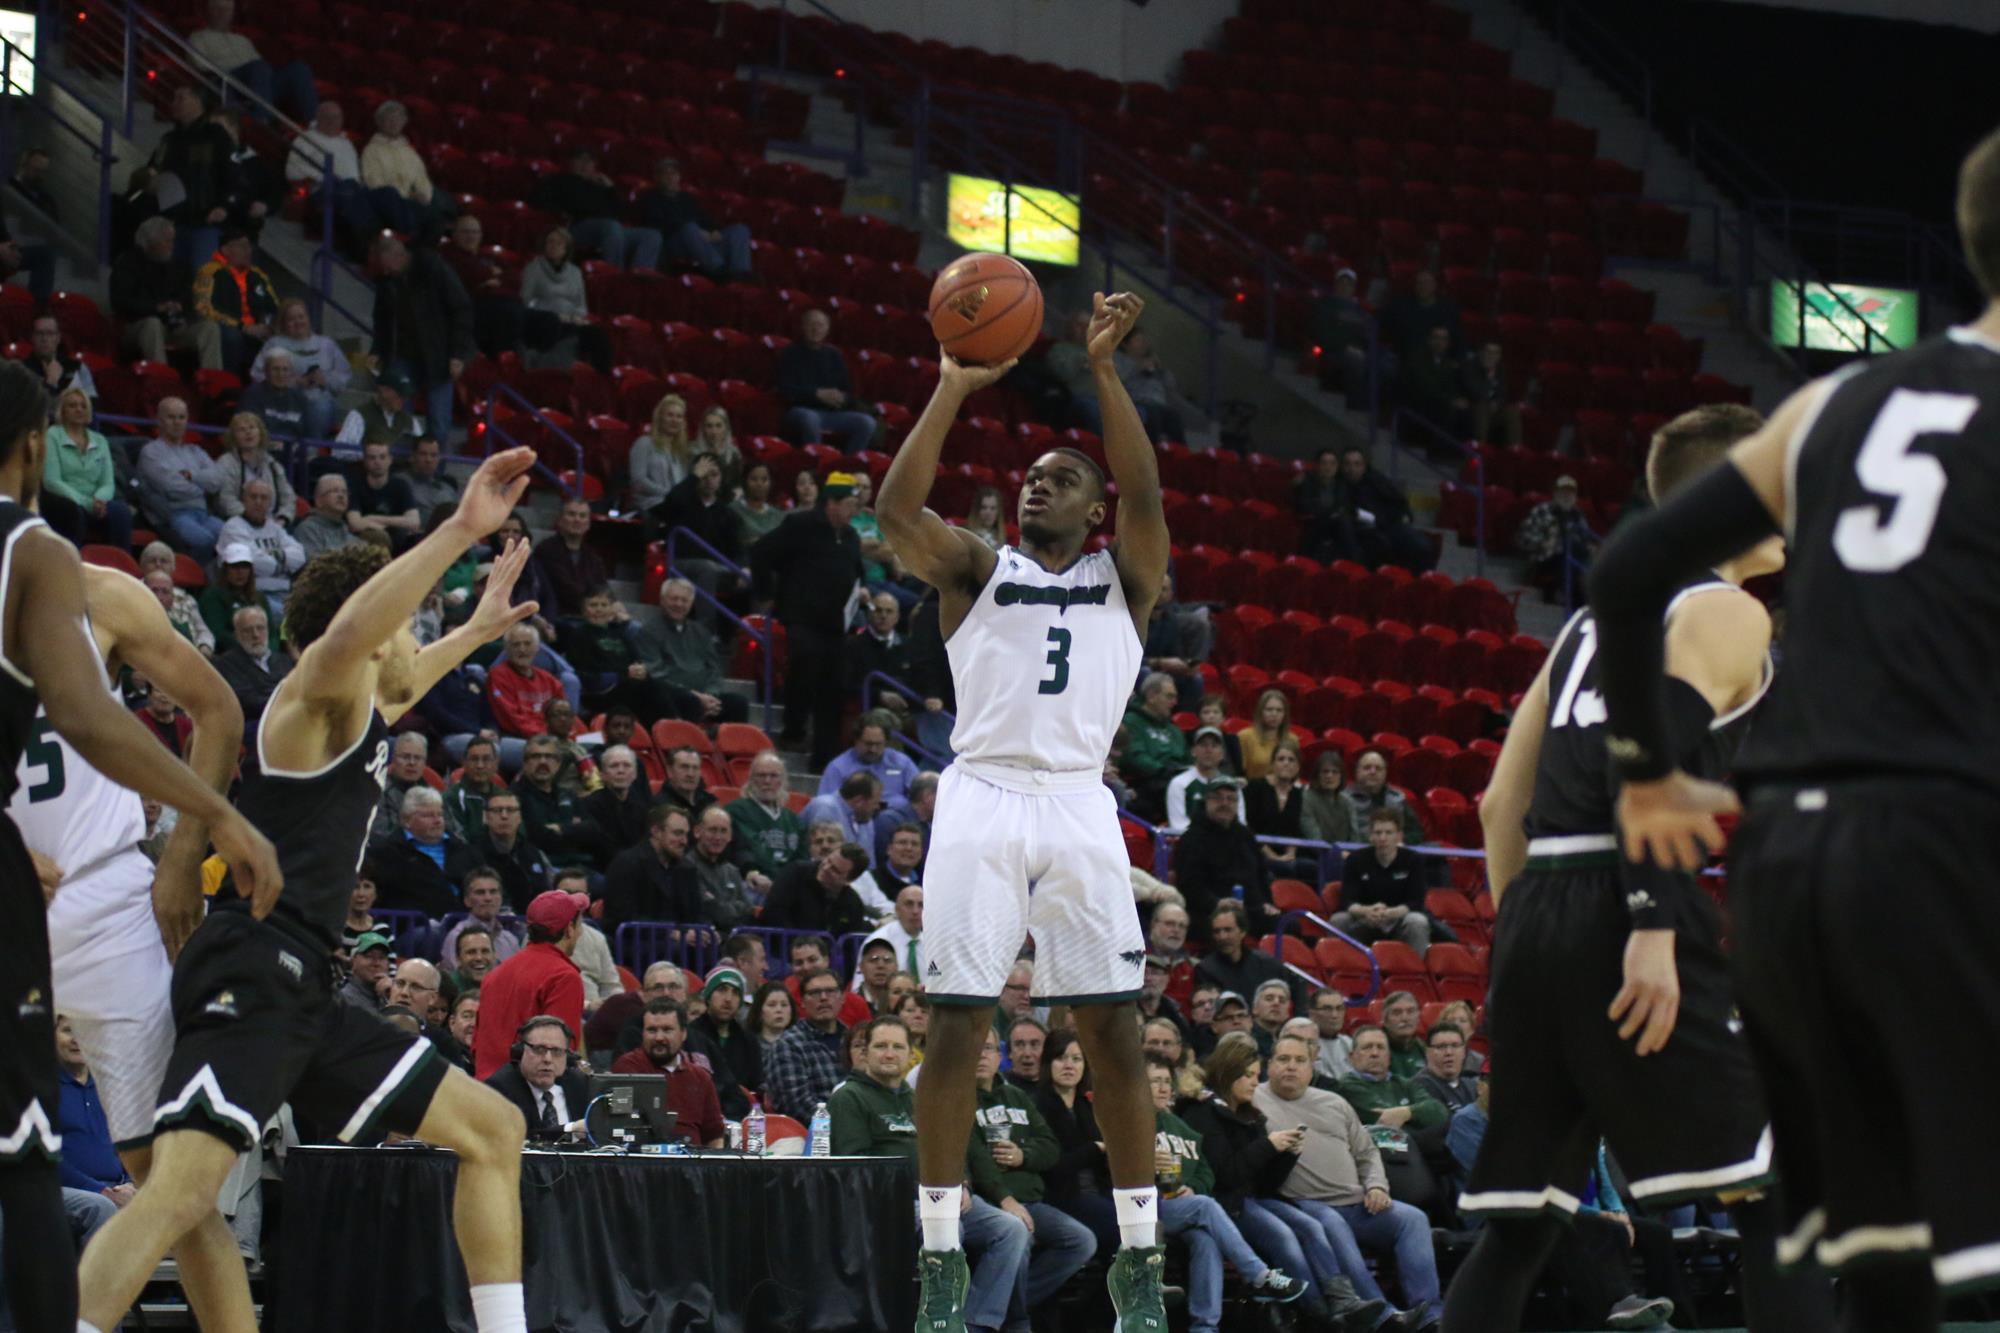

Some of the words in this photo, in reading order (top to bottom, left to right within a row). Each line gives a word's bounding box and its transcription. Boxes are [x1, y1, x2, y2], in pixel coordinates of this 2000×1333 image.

[1833, 386, 1981, 573] 5
[1037, 626, 1072, 695] 3
[25, 716, 66, 804] 5
